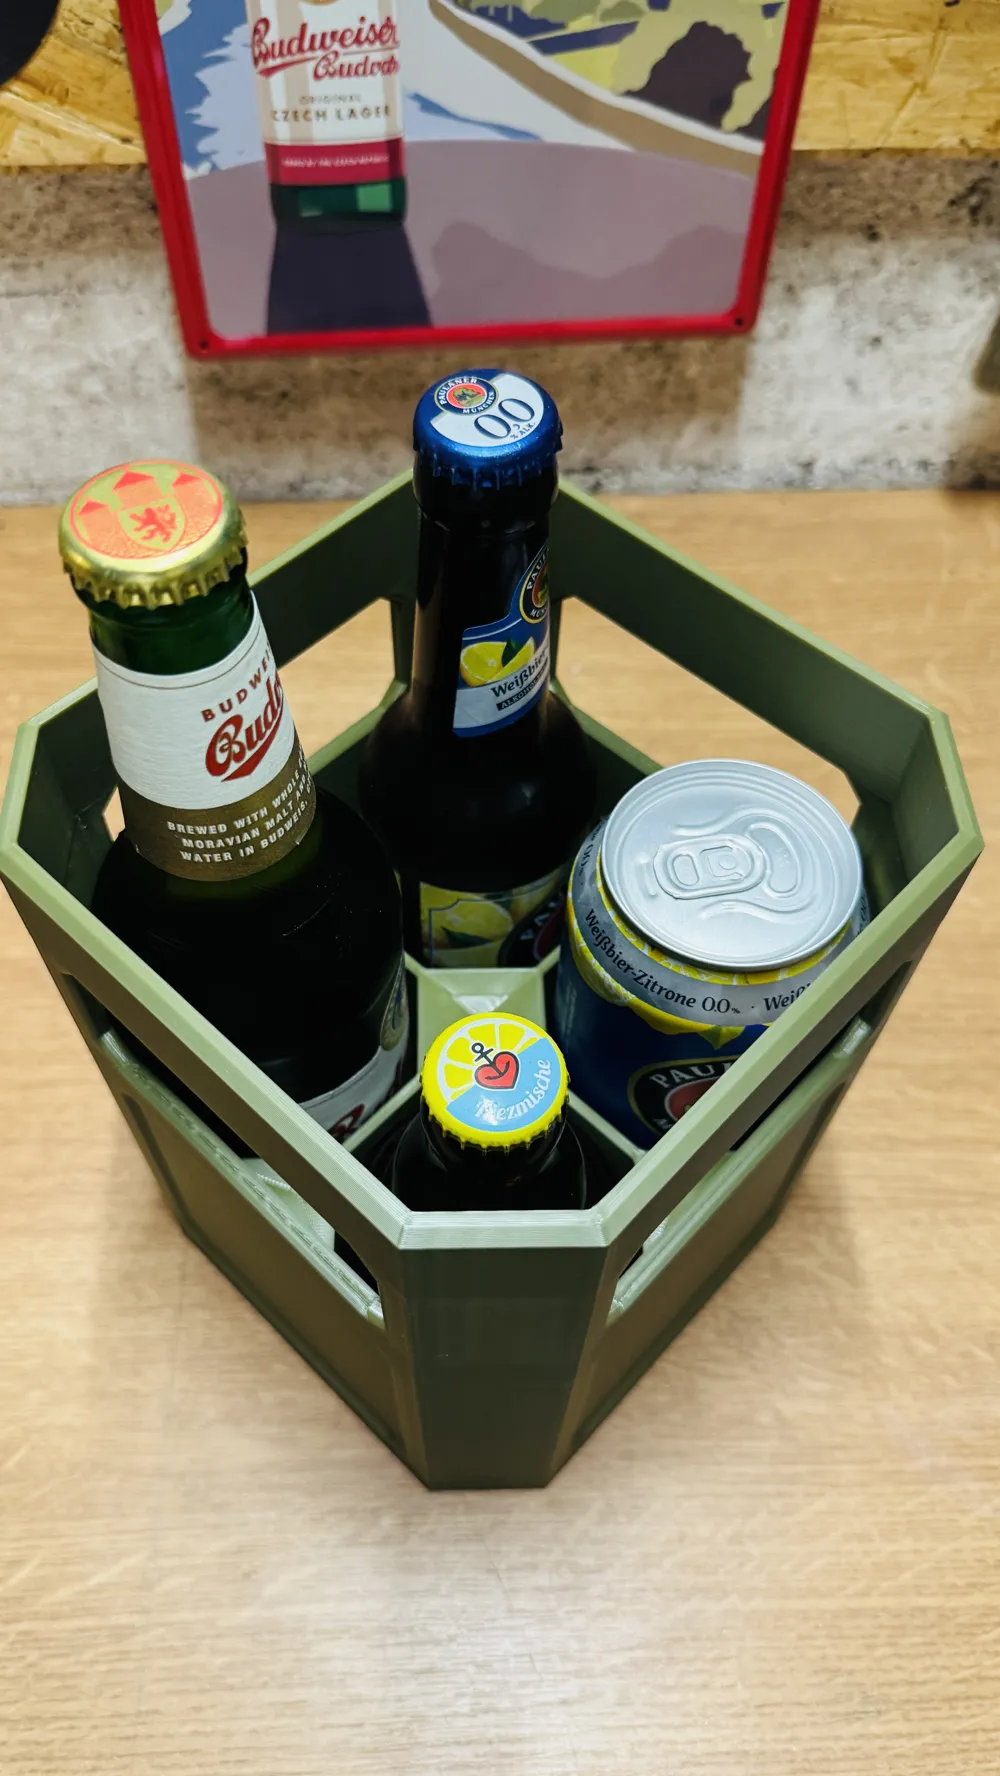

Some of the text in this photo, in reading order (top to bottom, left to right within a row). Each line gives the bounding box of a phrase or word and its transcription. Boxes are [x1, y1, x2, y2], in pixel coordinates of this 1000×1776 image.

[252, 16, 399, 69] Budweiser
[438, 376, 478, 405] PAULANER
[201, 640, 272, 723] BUDWEI
[491, 650, 547, 697] Weißbier
[167, 820, 228, 835] BREWED
[233, 807, 268, 829] WITH
[271, 769, 299, 809] WHOLE
[181, 826, 260, 849] MORAVIAN
[264, 800, 294, 831] MALT
[179, 850, 233, 863] WATER
[239, 845, 255, 858] IN
[584, 908, 697, 1008] Weißbier-Zitrone
